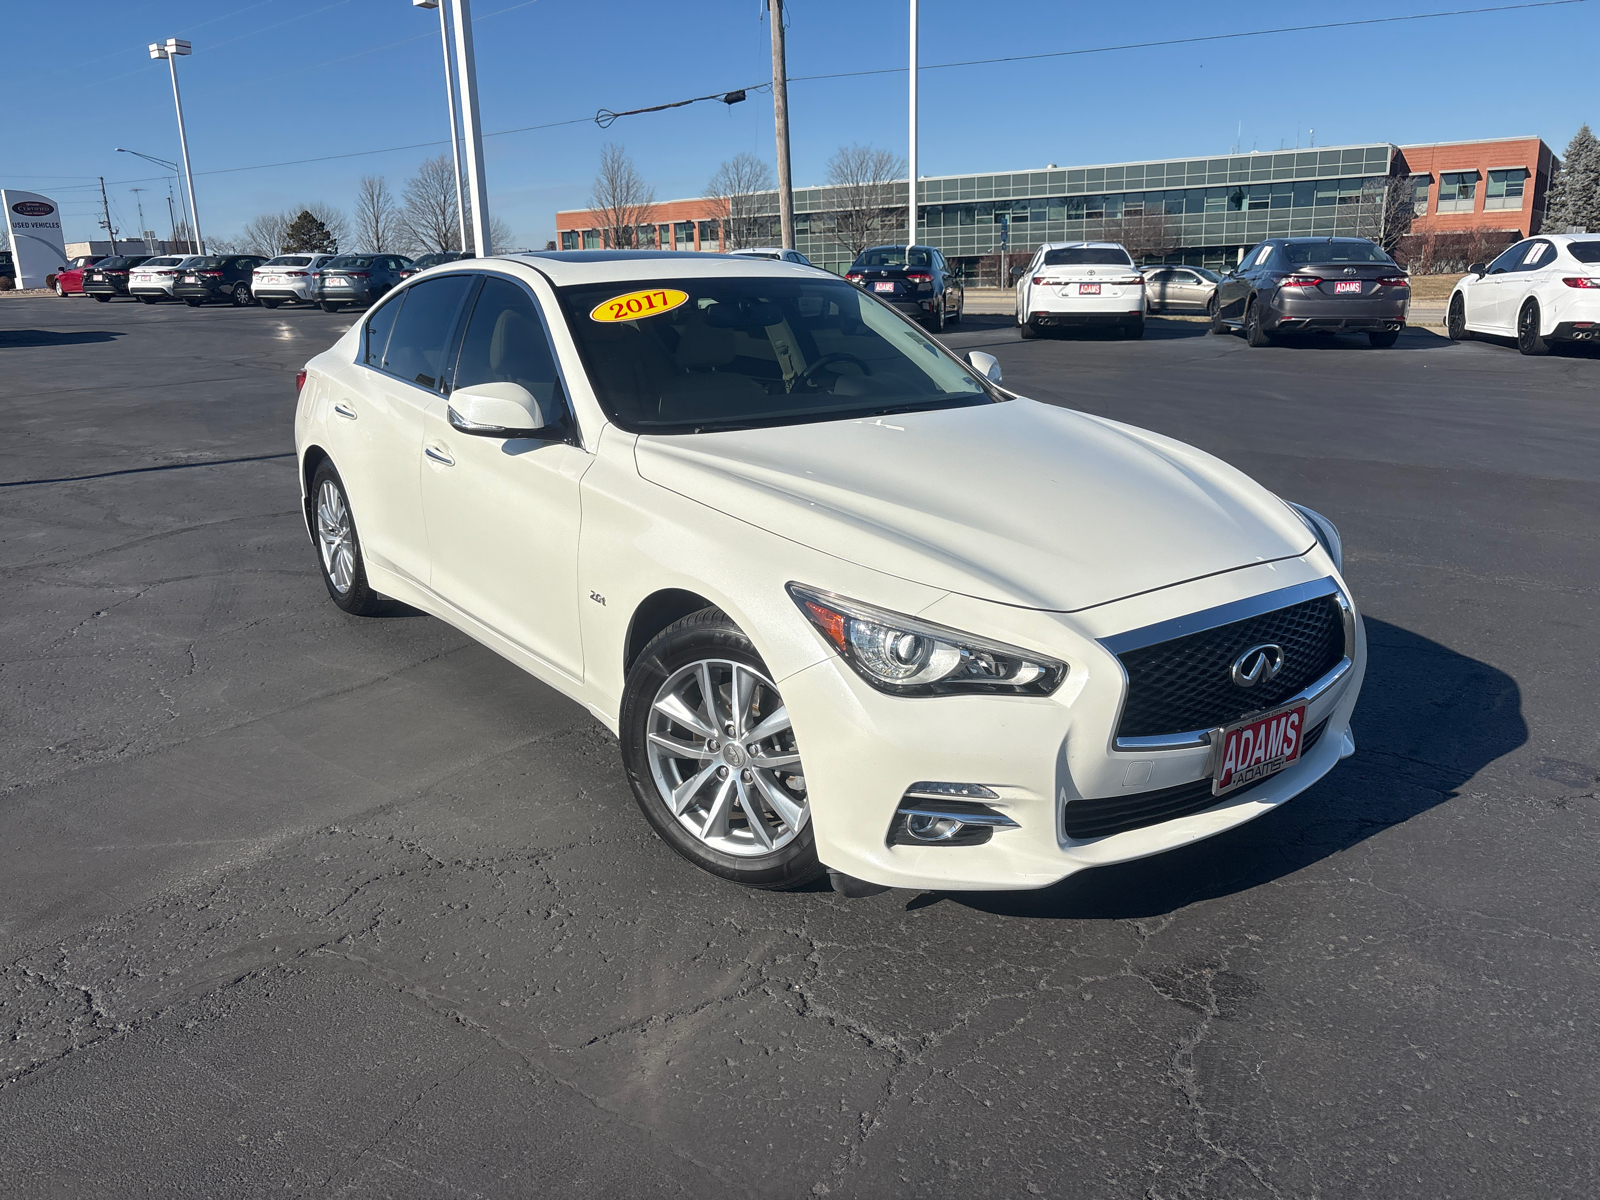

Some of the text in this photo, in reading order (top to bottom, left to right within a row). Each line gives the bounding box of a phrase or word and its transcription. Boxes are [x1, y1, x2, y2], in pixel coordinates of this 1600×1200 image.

[12, 221, 60, 229] USED VEHICLES
[875, 282, 893, 291] ADAMS
[1079, 284, 1100, 293] ADAMS
[1335, 282, 1360, 293] ADAMS
[609, 291, 669, 319] 2017
[1220, 712, 1299, 781] ADAMS
